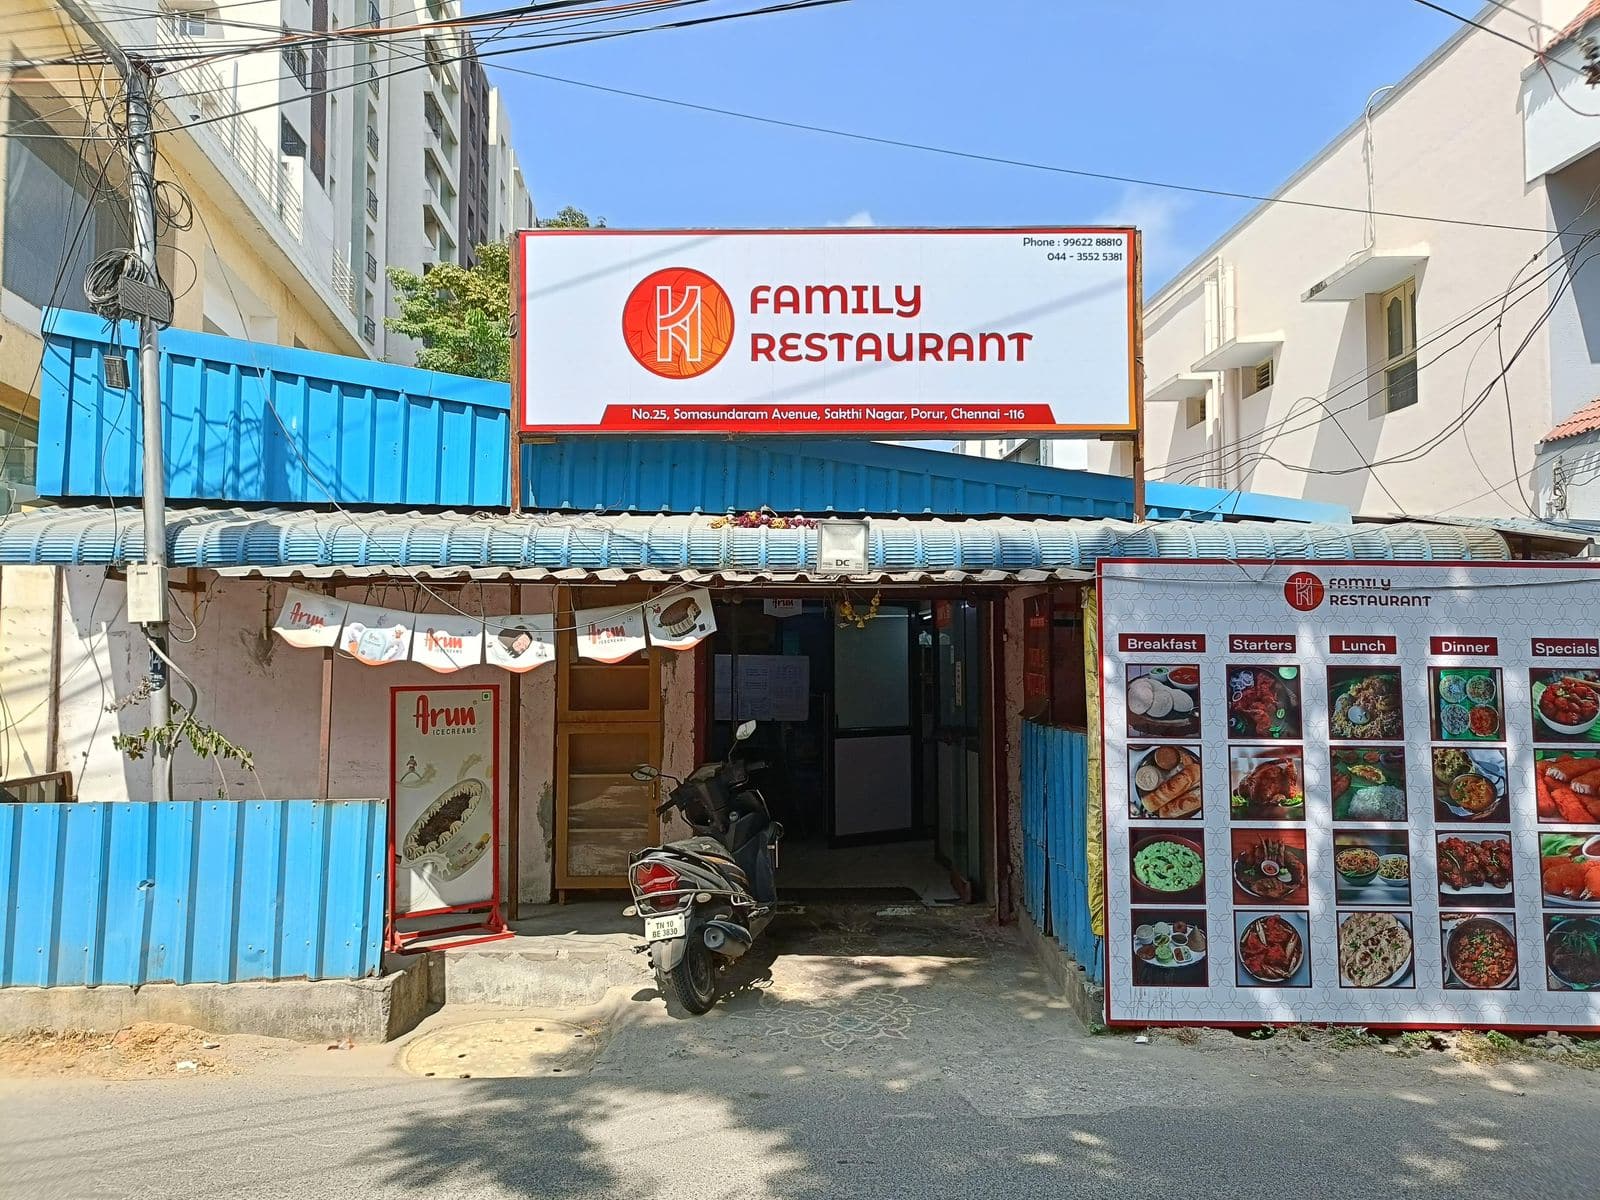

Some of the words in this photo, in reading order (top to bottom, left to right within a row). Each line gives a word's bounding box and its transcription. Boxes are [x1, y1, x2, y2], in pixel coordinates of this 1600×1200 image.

[1023, 237, 1055, 247] Phone
[1062, 238, 1093, 247] 99622
[1095, 238, 1123, 247] 88810
[1047, 252, 1067, 261] 044
[1077, 252, 1100, 261] 3552
[1102, 252, 1123, 261] 5381
[750, 285, 921, 318] FAMILY
[750, 332, 1033, 361] RESTAURANT
[631, 408, 670, 421] No.25,
[673, 408, 768, 420] Somasundaram
[771, 408, 821, 421] Avenue,
[824, 407, 862, 420] Sakthi
[865, 408, 908, 422] Nagar,
[911, 408, 948, 421] Porur,
[951, 407, 1001, 420] Chennai
[1003, 409, 1025, 420] -116
[835, 559, 850, 567] DC
[1330, 595, 1431, 607] RESTAURANT
[424, 628, 463, 652] Arun
[1127, 638, 1197, 650] Breakfast
[1233, 639, 1293, 651] Starters
[1341, 640, 1386, 652] Lunch
[1441, 641, 1490, 653] Dinner
[1535, 642, 1597, 657] Specials
[413, 694, 476, 735] Arun
[432, 727, 477, 736] ICECREAMS
[656, 922, 665, 930] TN
